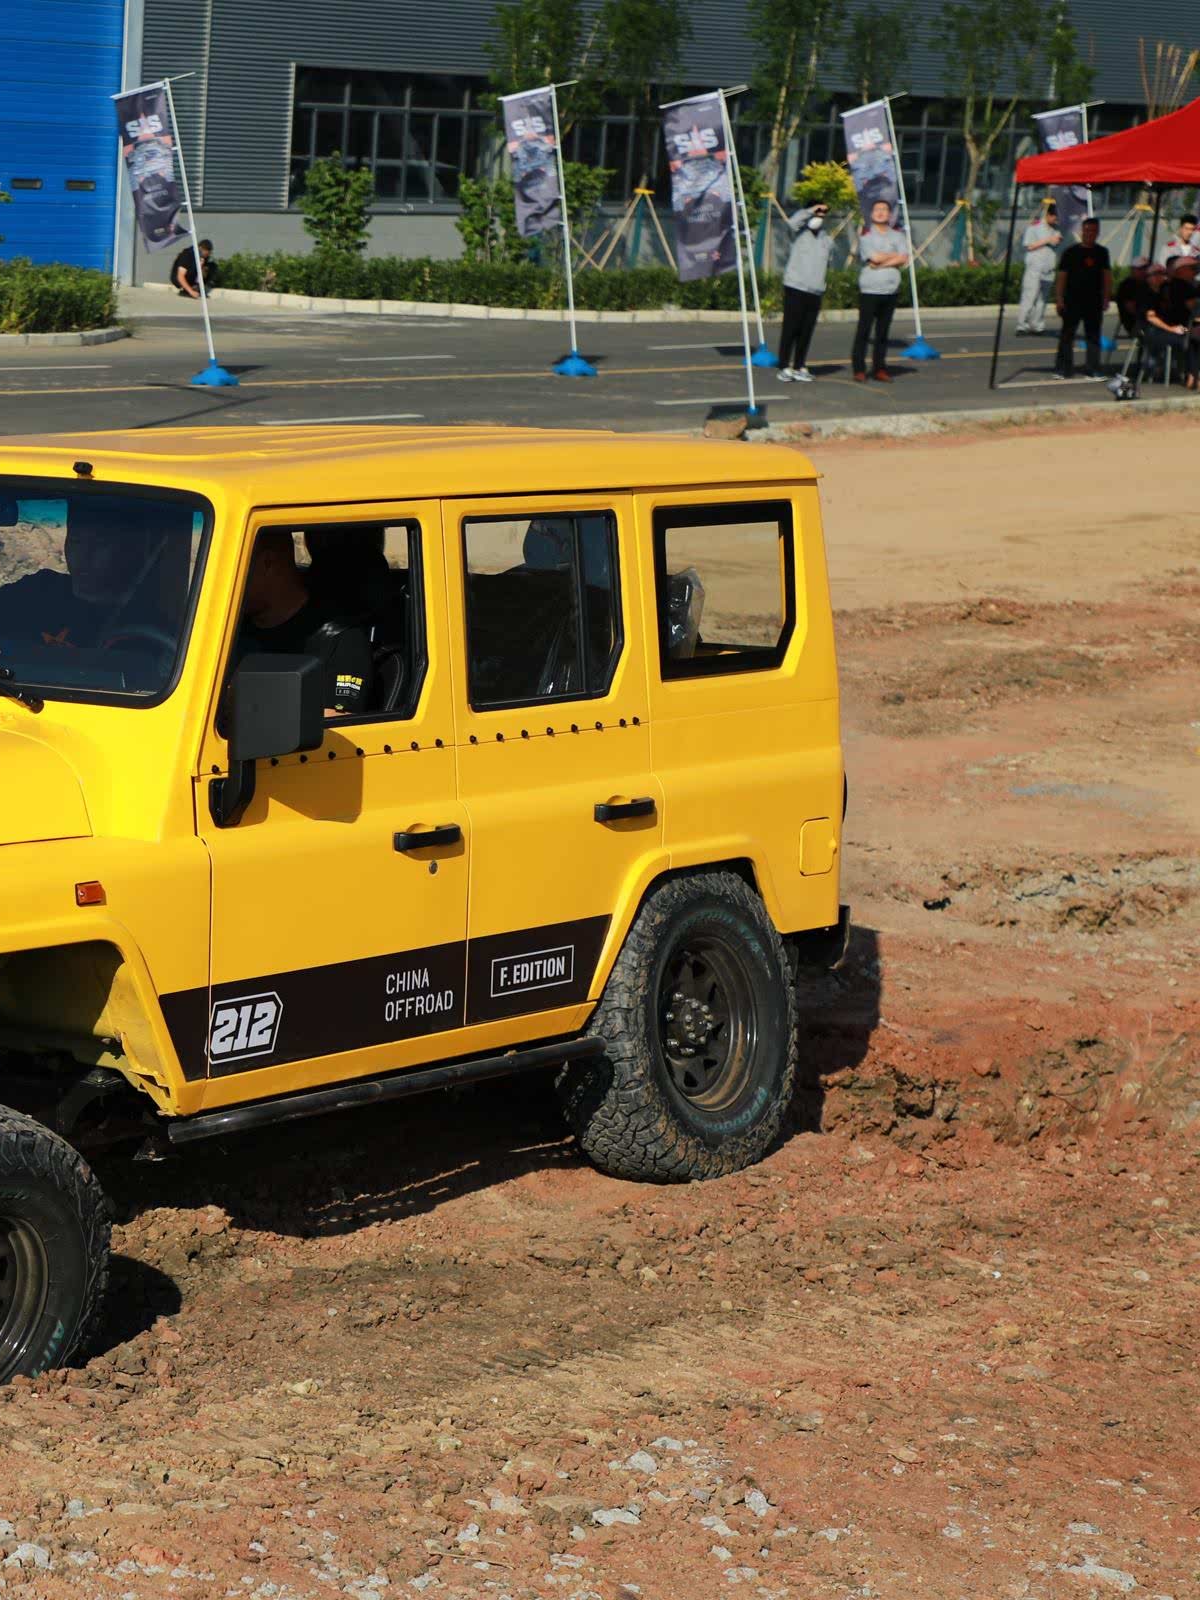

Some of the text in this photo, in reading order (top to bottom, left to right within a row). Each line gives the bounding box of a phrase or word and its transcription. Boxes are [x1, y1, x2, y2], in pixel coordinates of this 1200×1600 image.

[385, 967, 430, 995] CHINA
[384, 990, 454, 1022] OFFROAD
[211, 1000, 277, 1055] 212
